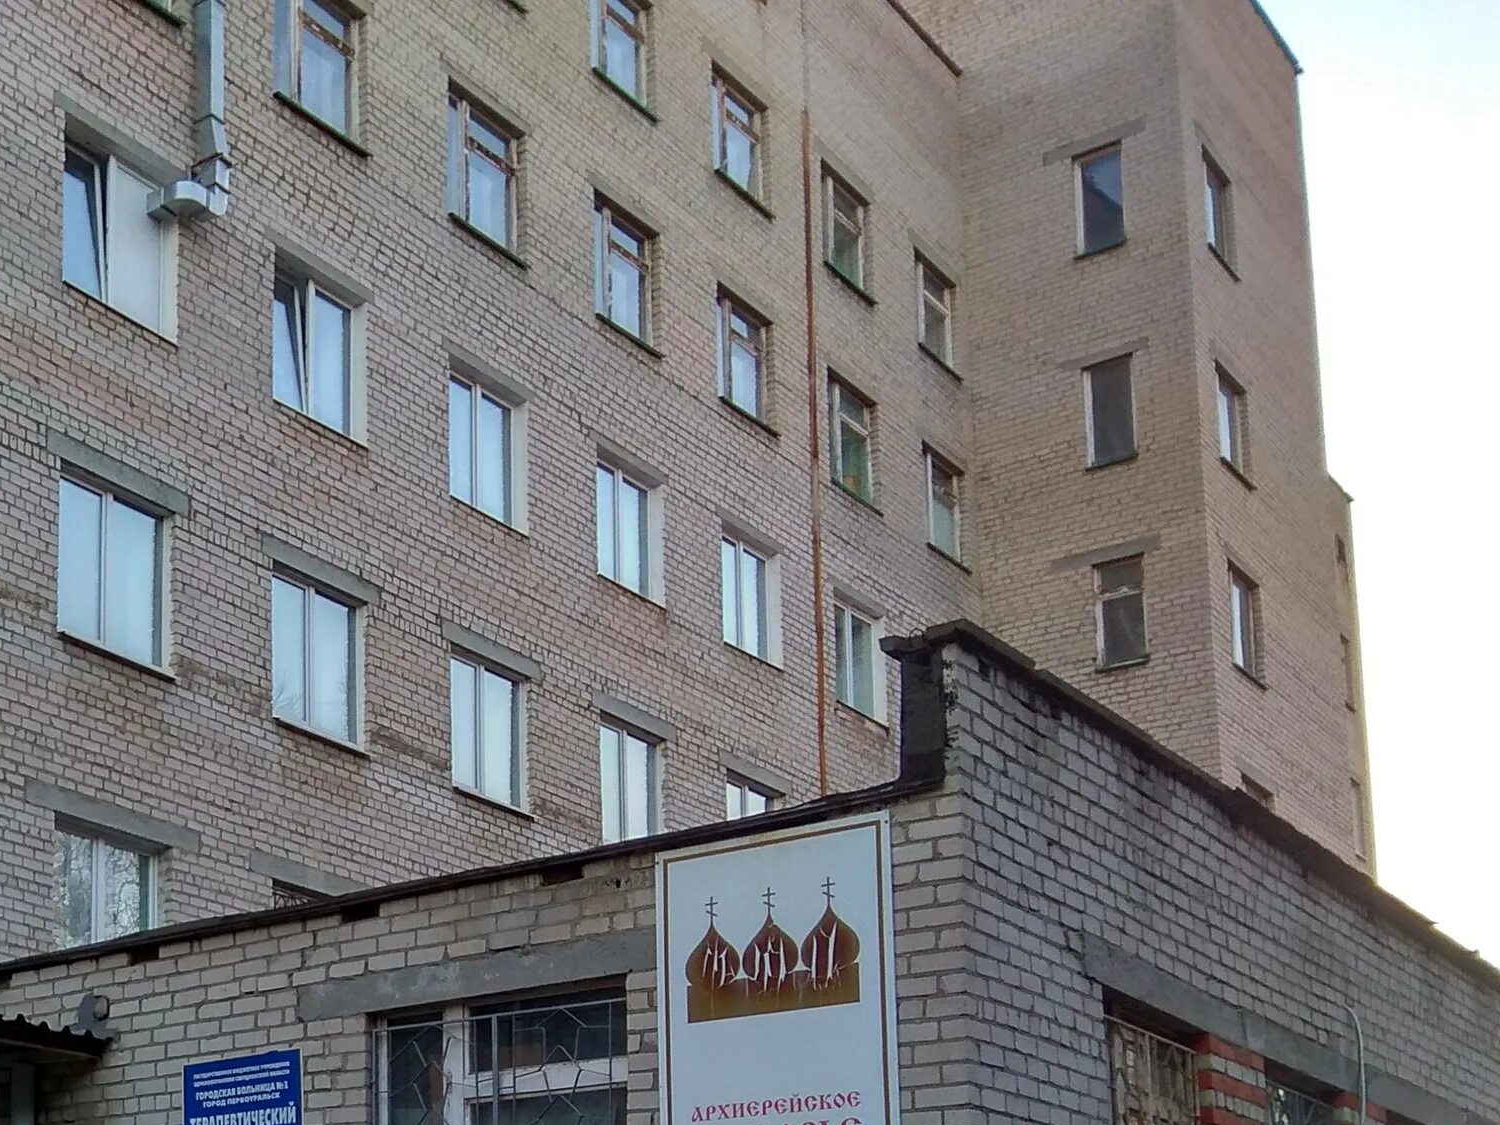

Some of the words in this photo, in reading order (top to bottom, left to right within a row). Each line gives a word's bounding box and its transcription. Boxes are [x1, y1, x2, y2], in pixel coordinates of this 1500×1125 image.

[195, 1087, 236, 1100] ГОРОДСКАЯ
[236, 1082, 275, 1095] БОЛЬНИЦА
[202, 1100, 226, 1108] ГОРОД
[226, 1092, 281, 1105] ПЕРВОУРАЛЬСК
[692, 1090, 861, 1122] АРХИЕРЕЙСКОЕ
